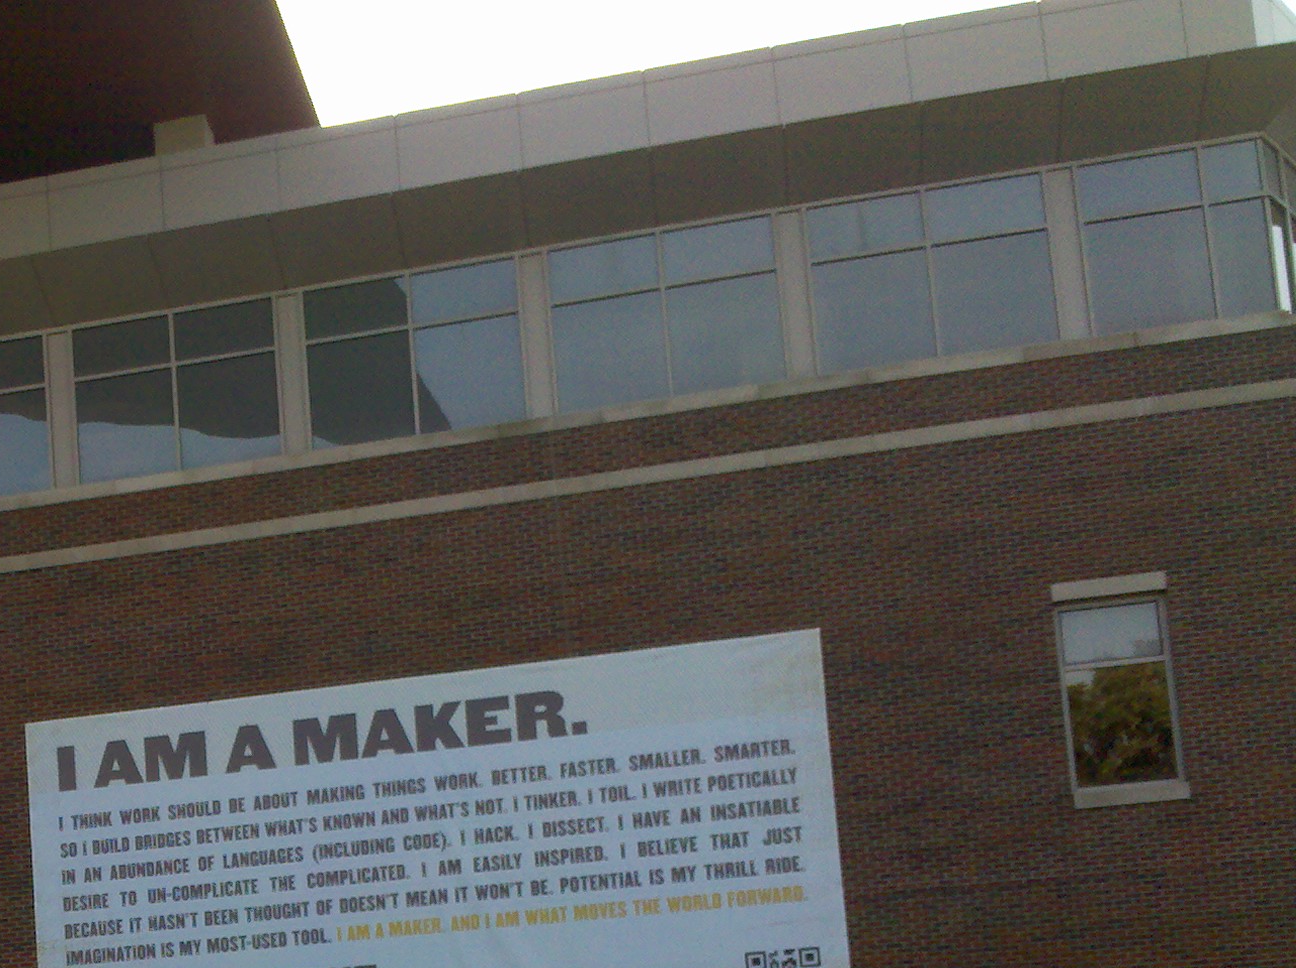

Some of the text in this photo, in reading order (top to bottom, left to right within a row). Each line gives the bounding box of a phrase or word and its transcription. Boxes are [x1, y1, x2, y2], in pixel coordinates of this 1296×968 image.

[56, 691, 589, 792] I AM A MAKER.
[59, 841, 78, 858] SO
[91, 836, 129, 855] BUILD
[134, 830, 191, 850] BRIDGES
[195, 823, 259, 844] BETWEEN
[322, 811, 375, 831] KNOWN
[380, 807, 409, 825] AND
[652, 777, 702, 797] WRITE
[706, 766, 796, 791] POETICALLY
[60, 868, 76, 885] IN
[83, 866, 102, 883] AN
[109, 857, 189, 880] ABUNDANCE
[197, 854, 214, 871] OF
[222, 846, 303, 869] LANGUAGES
[312, 836, 395, 862] (INCLUDING
[631, 809, 670, 829] HAVE
[679, 806, 701, 824] AN
[710, 796, 800, 821] INSATIABLE
[70, 811, 112, 830] THINK
[119, 805, 160, 824] WORK
[167, 799, 221, 820] SHOULD
[227, 796, 245, 813] BE
[253, 791, 297, 810] ABOUT
[306, 784, 364, 805] MAKING
[372, 777, 426, 798] THINGS
[62, 892, 109, 912] DESIRE
[119, 890, 137, 906] TO
[147, 878, 258, 903] UN-COMPLICATE
[268, 874, 295, 892] THE
[438, 858, 462, 876] AM
[472, 852, 521, 872] EASILY
[636, 835, 697, 857] BELIEVE
[709, 830, 749, 850] THAT
[762, 825, 802, 846] JUST
[63, 918, 123, 940] BECAUSE
[128, 916, 141, 933] IT
[203, 908, 238, 926] BEEN
[244, 900, 309, 922] THOUGHT
[315, 898, 332, 915] OF
[404, 888, 448, 907] MEAN
[454, 885, 467, 902] IT
[559, 870, 641, 893] POTENTIAL
[648, 867, 664, 885] IS
[670, 864, 696, 883] MY
[703, 859, 758, 880] THRILL
[65, 943, 156, 966] IMAGINATION
[160, 941, 174, 958] IS
[178, 938, 201, 956] MY
[206, 931, 287, 953] MOST-USED
[346, 923, 370, 941] AM
[374, 922, 384, 938] A
[450, 913, 480, 932] AND
[495, 910, 520, 928] AM
[524, 905, 567, 925] WHAT
[572, 900, 627, 921] MOVES
[632, 897, 661, 916] THE
[666, 892, 722, 912] WORLD
